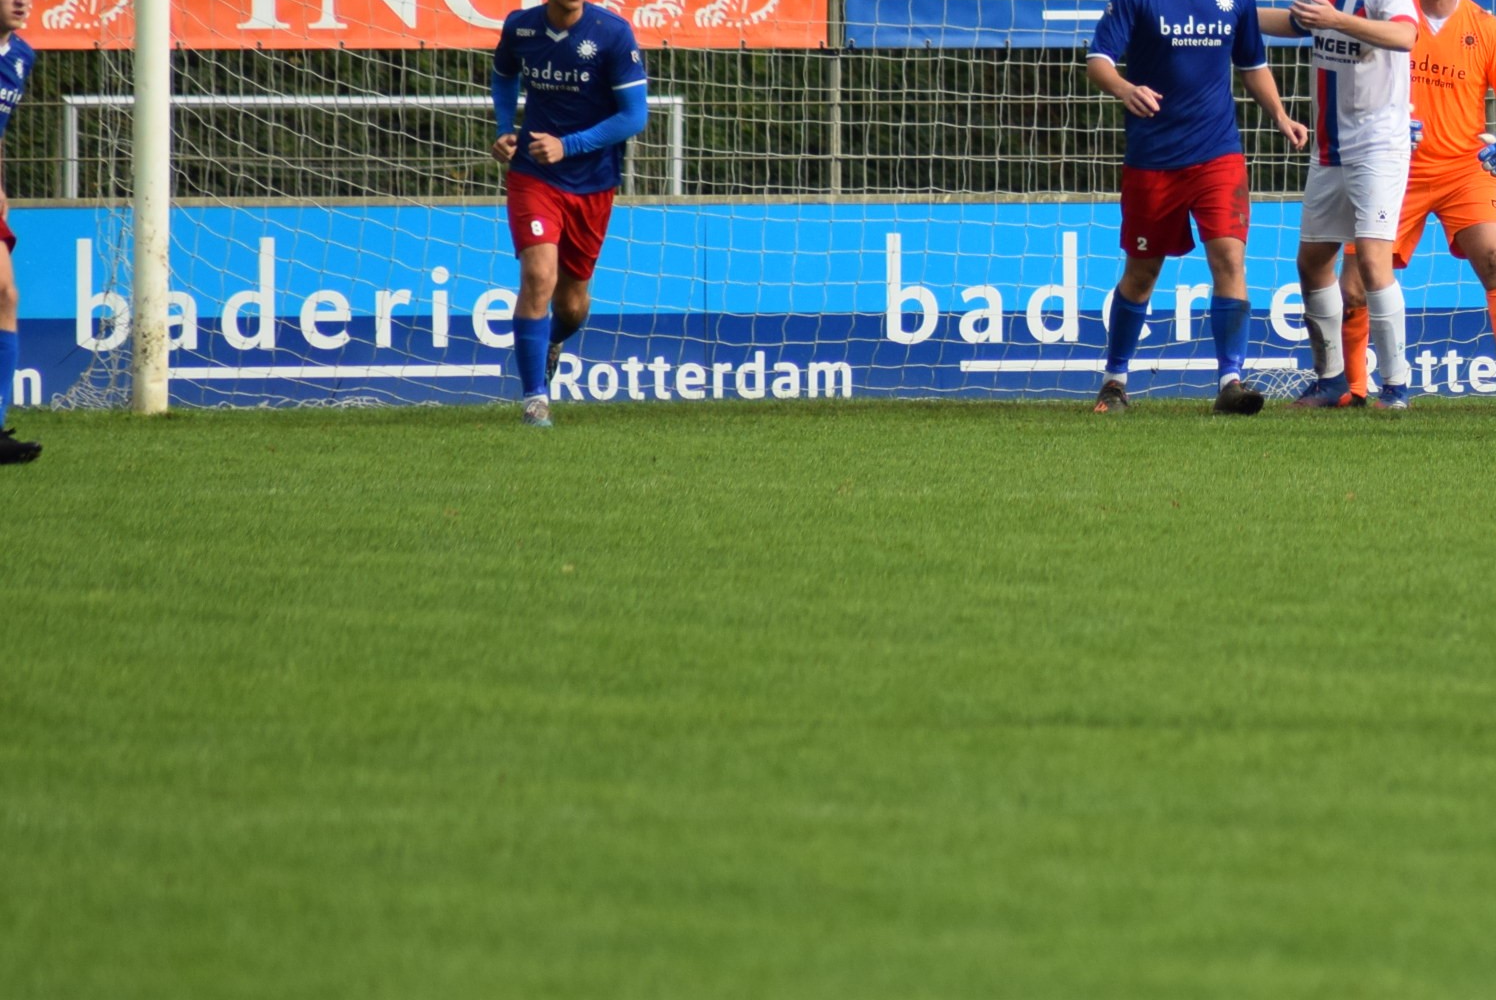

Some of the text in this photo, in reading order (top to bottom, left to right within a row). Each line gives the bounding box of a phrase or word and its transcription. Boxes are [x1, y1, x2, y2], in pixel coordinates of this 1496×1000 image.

[1160, 15, 1232, 35] baderie
[1172, 37, 1222, 47] Rotterdam
[1314, 36, 1361, 56] NGER
[522, 58, 590, 82] baderie
[1410, 54, 1466, 80] aderie
[1411, 75, 1454, 88] otterdam
[530, 220, 544, 236] 8
[1137, 237, 1148, 251] 2
[551, 350, 852, 400] Rotterdam
